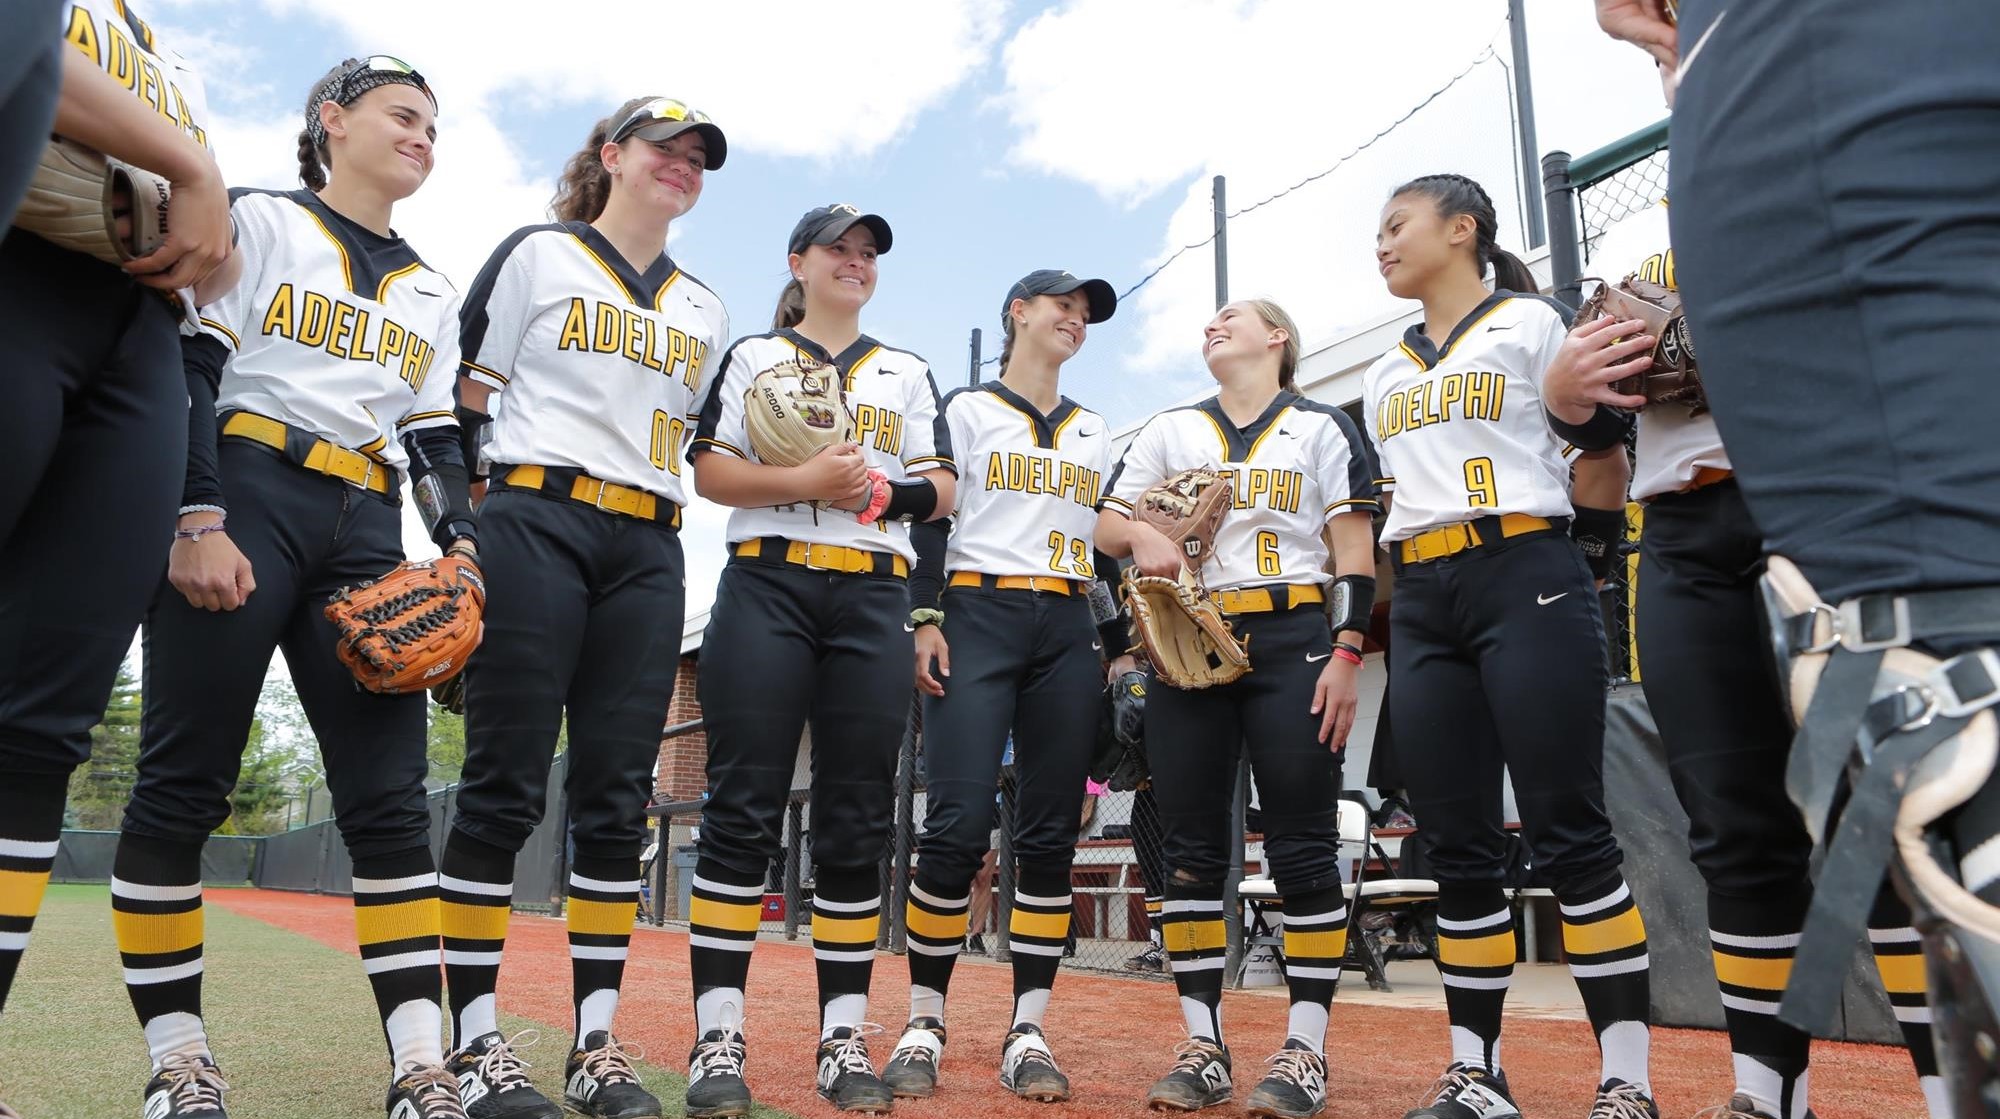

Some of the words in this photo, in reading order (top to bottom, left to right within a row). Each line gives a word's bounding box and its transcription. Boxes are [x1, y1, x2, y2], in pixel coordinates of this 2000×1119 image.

[262, 283, 436, 395] ADELPHI
[558, 297, 708, 396] ADELPH
[763, 387, 786, 420] A2000
[1377, 372, 1506, 447] ADELPHI
[985, 451, 1101, 508] ADELPHI
[1463, 456, 1499, 508] 9
[1048, 530, 1095, 578] 23
[1256, 530, 1282, 577] 6
